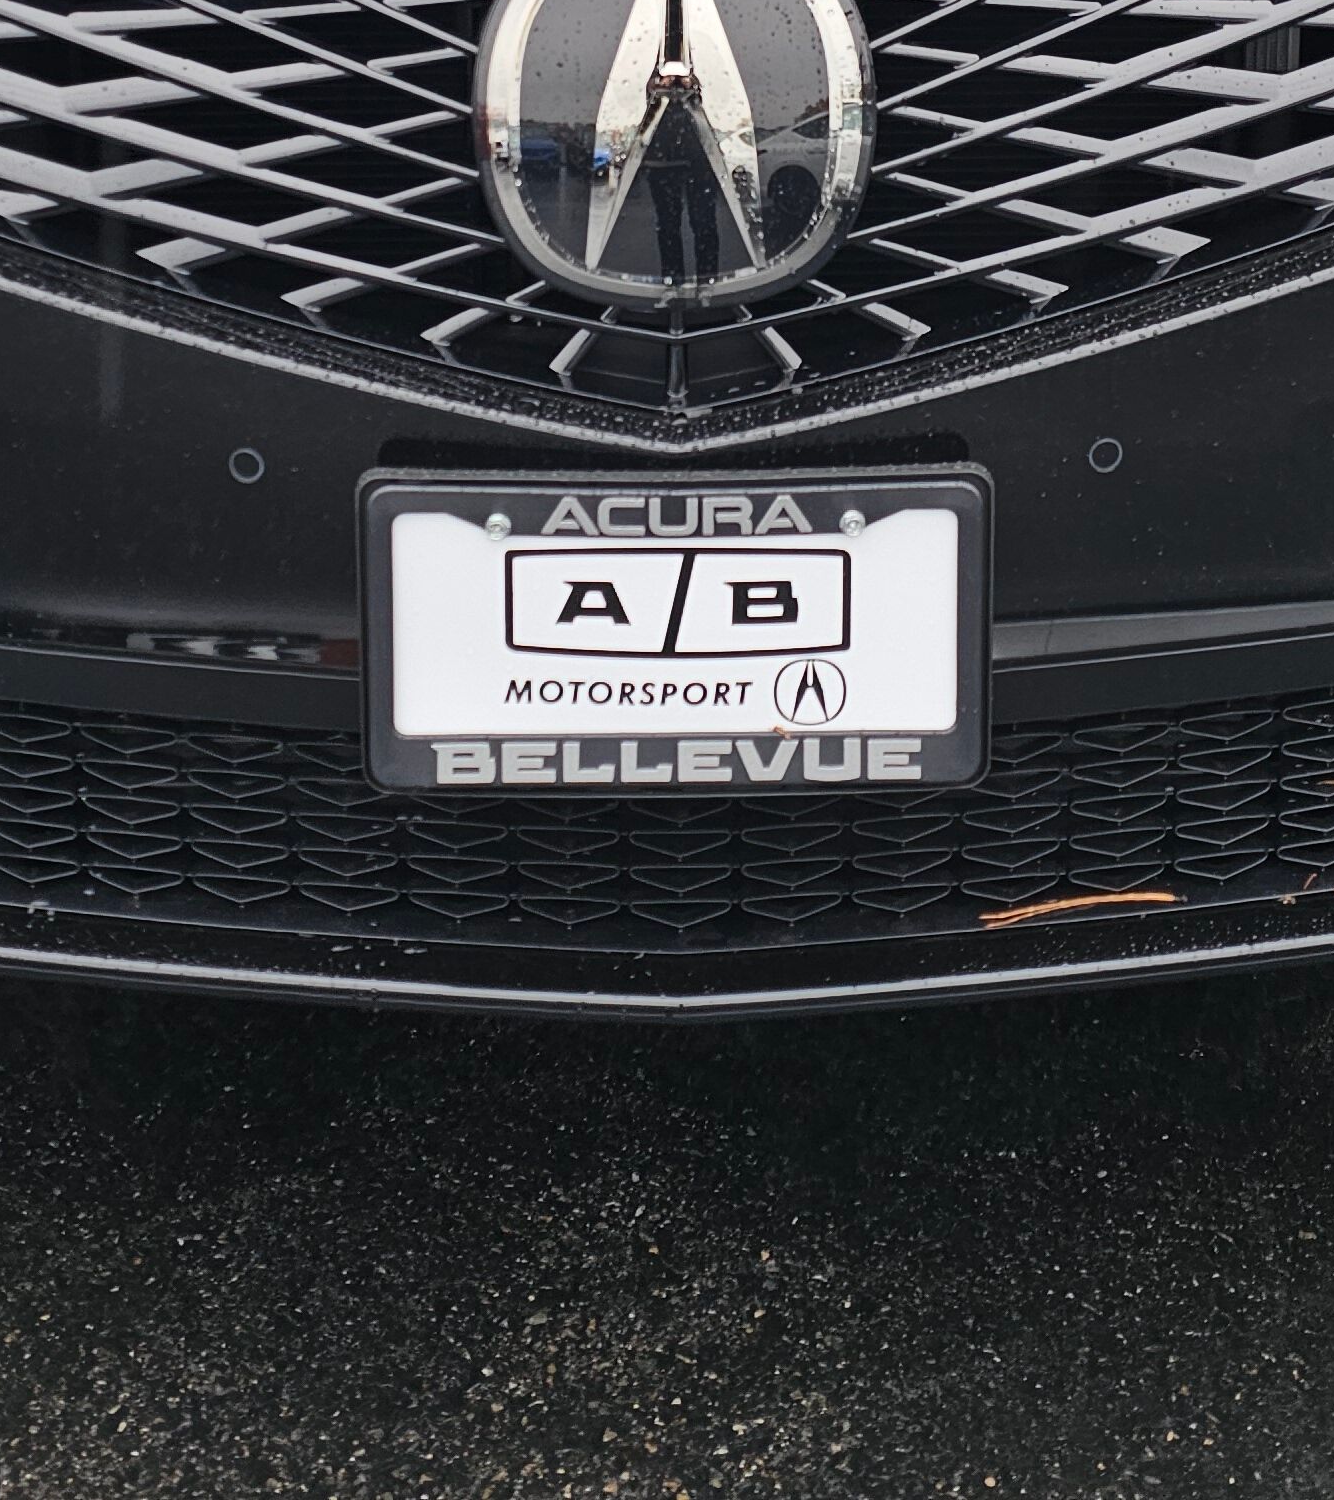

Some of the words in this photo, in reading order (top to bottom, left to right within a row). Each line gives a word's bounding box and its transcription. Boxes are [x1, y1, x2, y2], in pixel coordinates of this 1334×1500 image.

[541, 494, 813, 537] ACURA
[556, 580, 630, 625] A
[724, 580, 799, 625] B
[504, 679, 754, 706] MOTORSPORT
[430, 737, 923, 785] BELLEVUE
